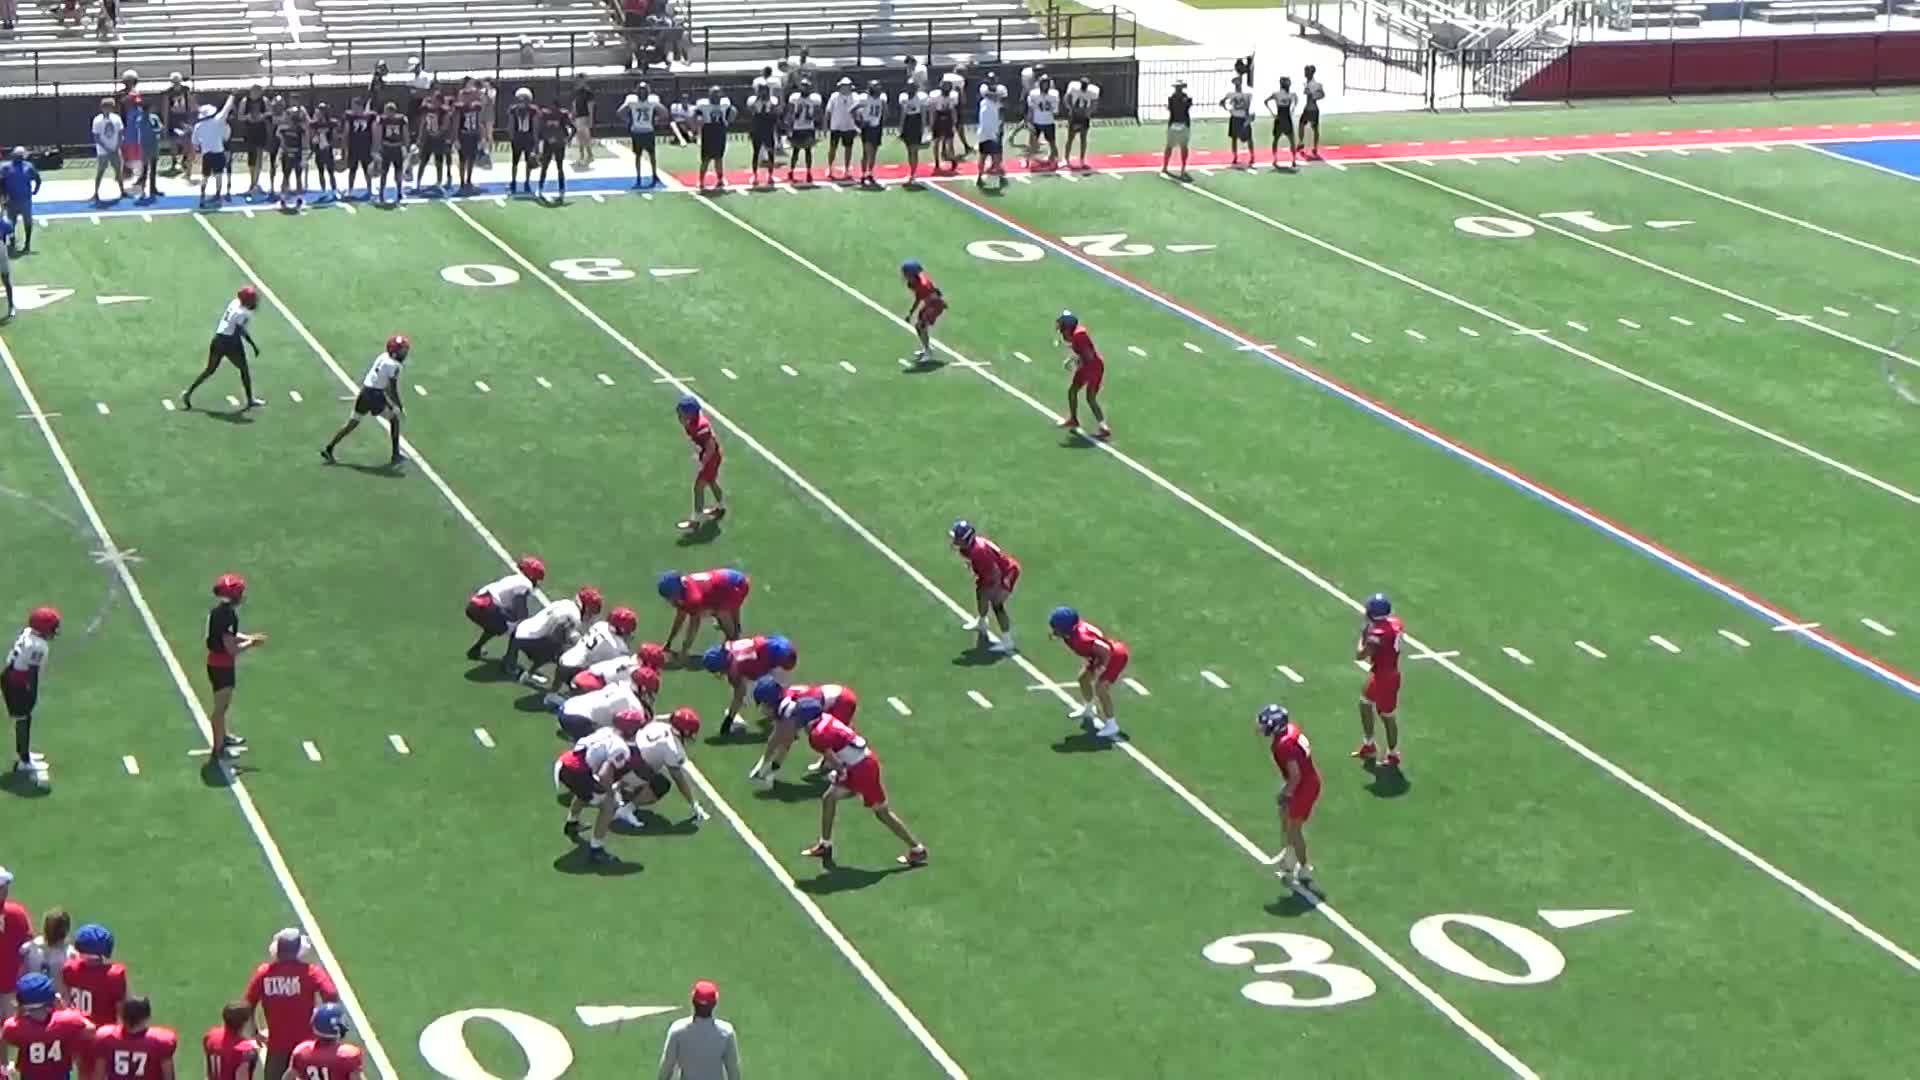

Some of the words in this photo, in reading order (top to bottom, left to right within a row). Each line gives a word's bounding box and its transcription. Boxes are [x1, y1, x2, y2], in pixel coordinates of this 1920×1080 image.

[1453, 209, 1632, 239] 10
[966, 232, 1156, 262] 20
[440, 257, 636, 286] 30
[1202, 913, 1566, 1007] 30
[69, 987, 93, 1015] 30
[29, 1039, 62, 1064] 84
[418, 1008, 573, 1080] 0
[114, 1050, 148, 1076] 57
